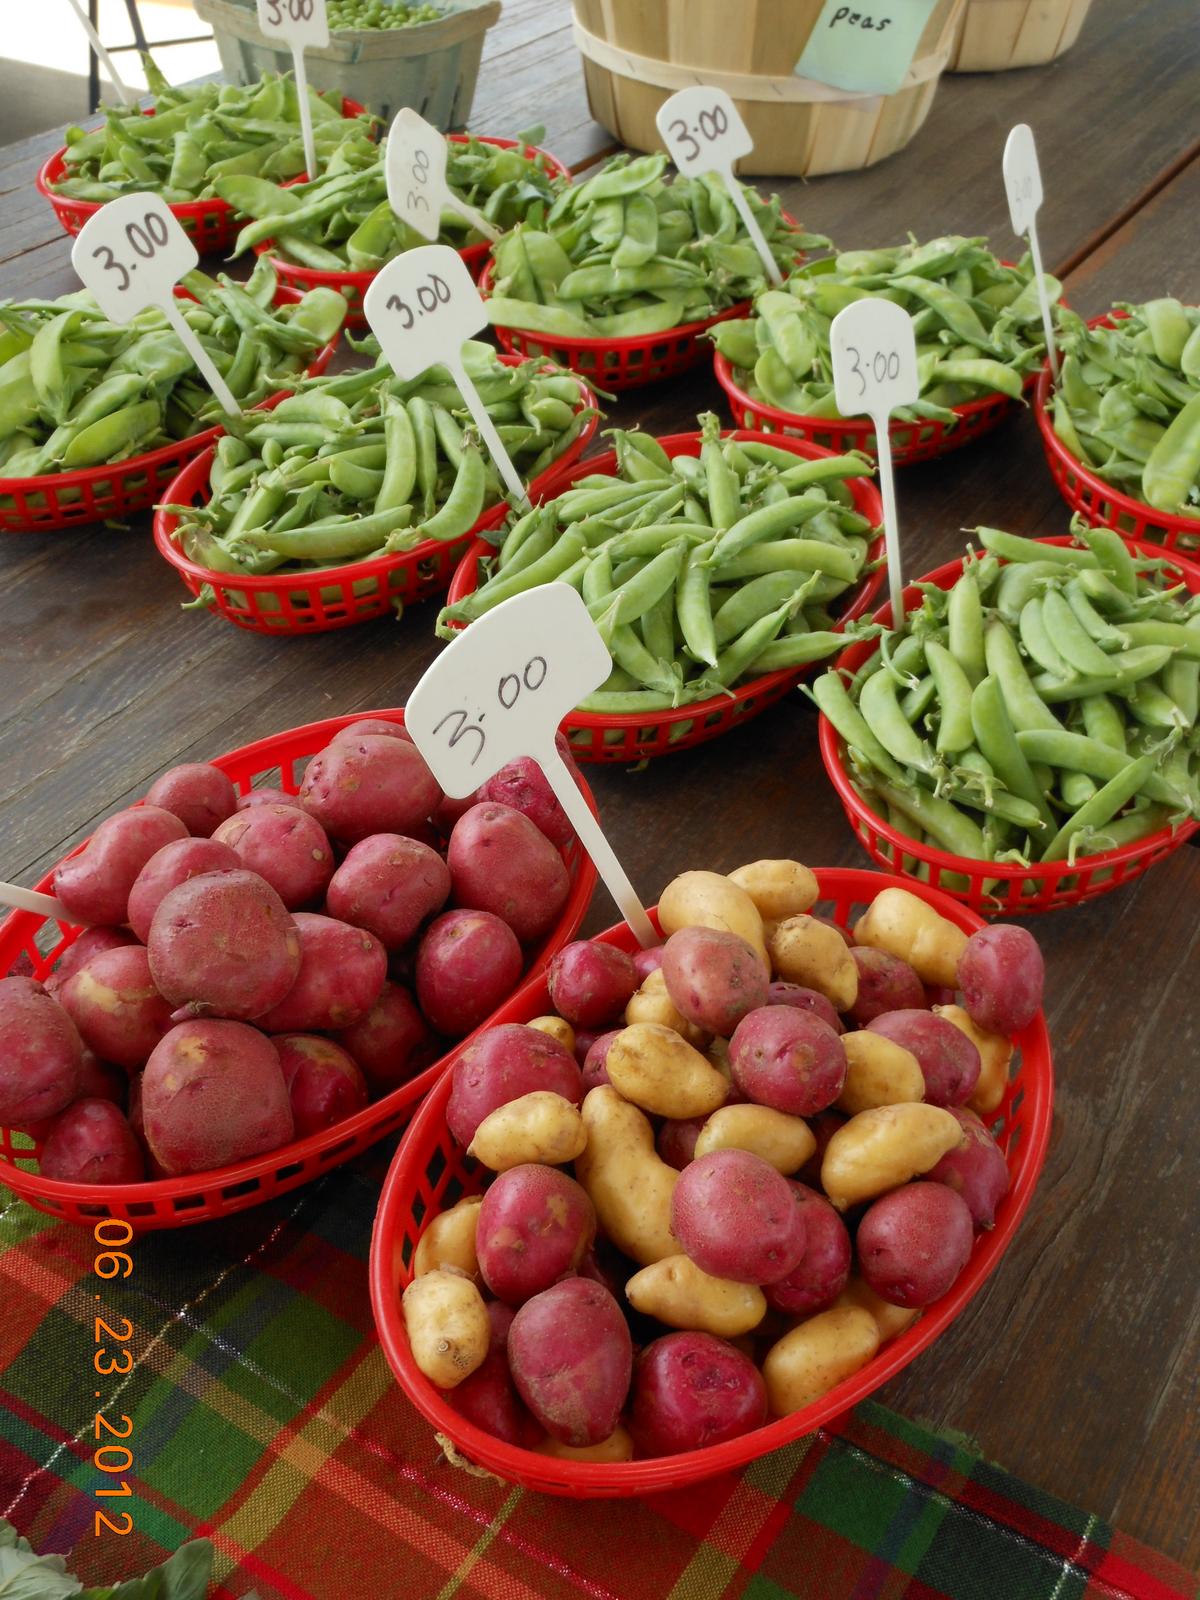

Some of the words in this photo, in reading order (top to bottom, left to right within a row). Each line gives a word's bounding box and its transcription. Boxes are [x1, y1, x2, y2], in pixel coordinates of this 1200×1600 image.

[668, 104, 728, 161] 3.00
[407, 150, 429, 212] 3.00
[91, 212, 168, 291] 3.00
[386, 274, 451, 330] 3.00
[846, 347, 899, 396] 3.00
[432, 656, 547, 766] 3.00
